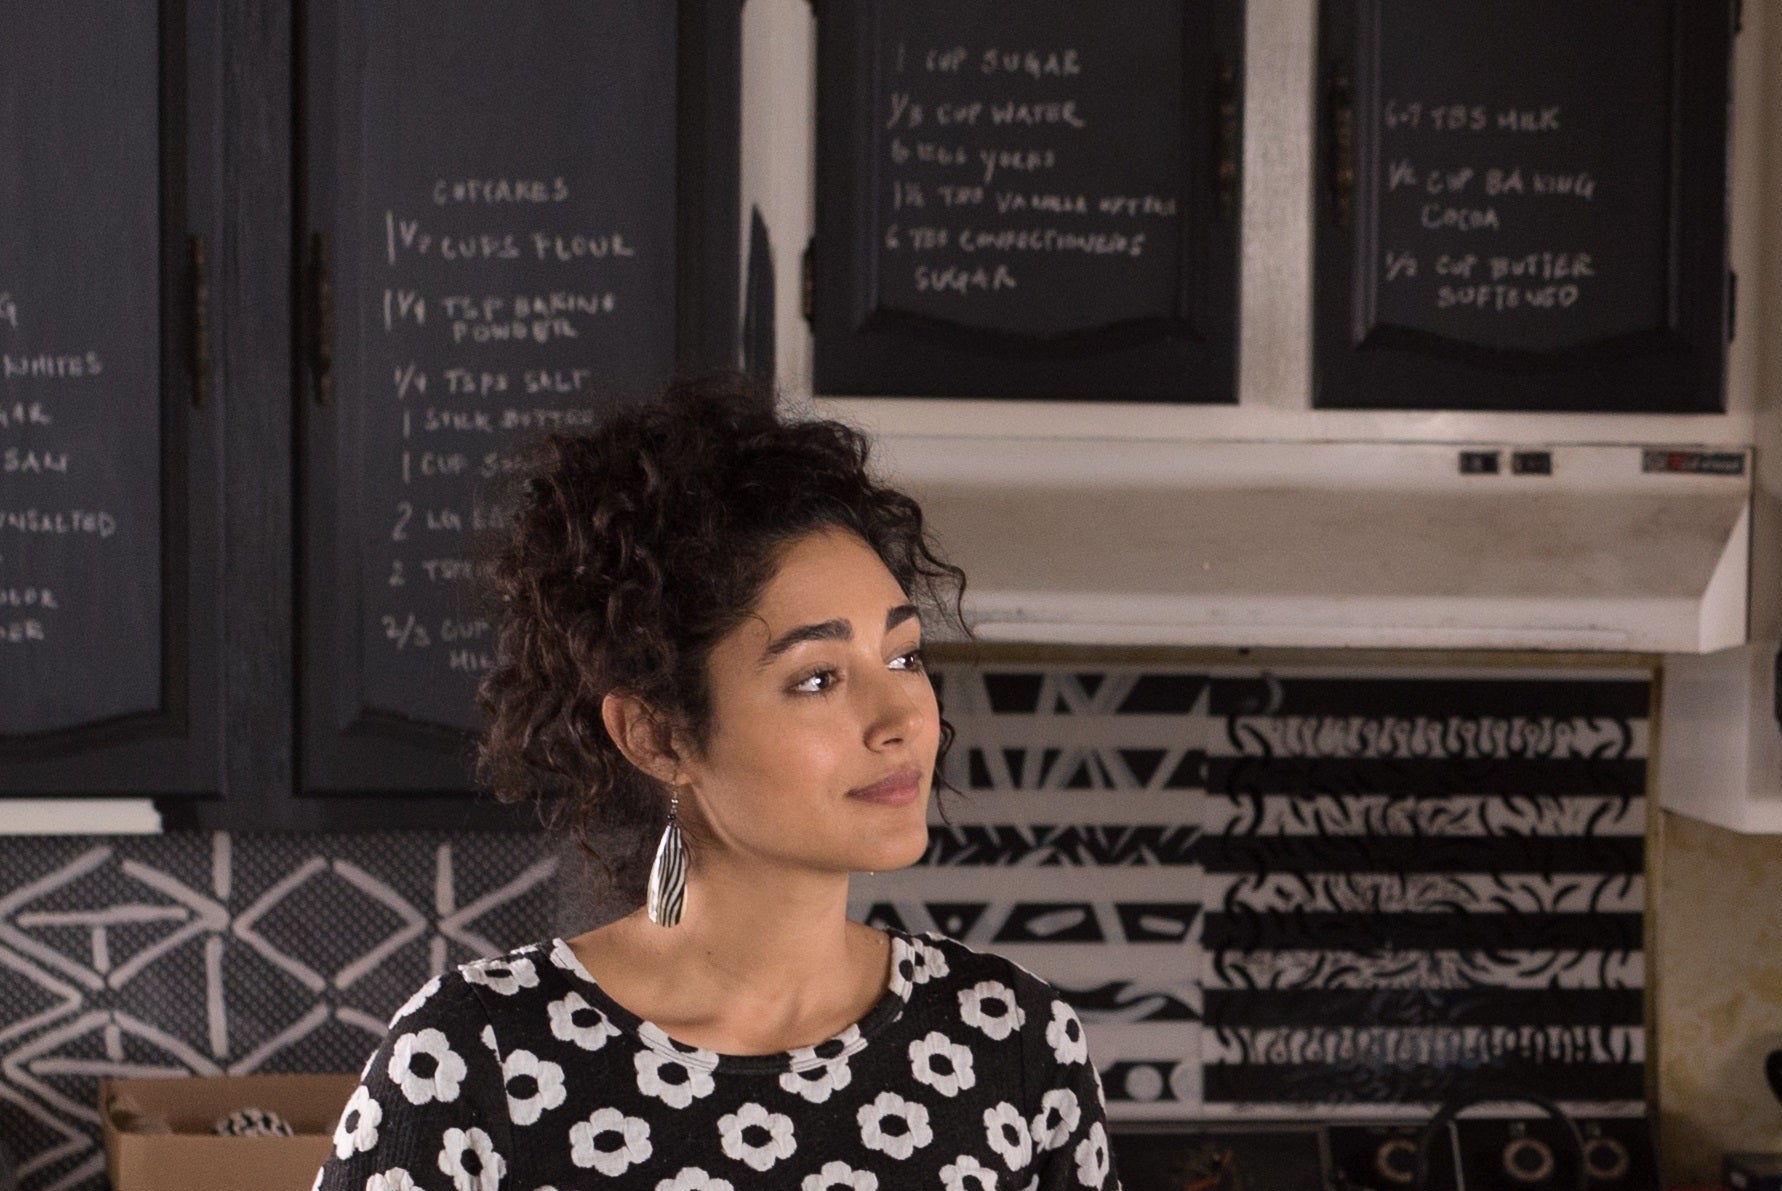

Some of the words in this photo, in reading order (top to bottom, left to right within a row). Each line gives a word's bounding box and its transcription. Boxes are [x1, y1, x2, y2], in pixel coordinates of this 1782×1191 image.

[981, 48, 1081, 79] SUGAR
[936, 102, 983, 126] CUP
[991, 100, 1085, 128] WATER
[432, 177, 569, 206] CUPCAKES
[1484, 168, 1595, 199] BAKING
[1420, 203, 1500, 231] COCOA
[440, 234, 520, 260] CUPS
[532, 232, 634, 262] FLOUR
[915, 264, 1017, 294] SUGAR
[1489, 252, 1594, 281] BUTTER
[441, 296, 504, 324] TSP
[514, 293, 615, 318] BAKING
[1436, 284, 1579, 311] SOFTENED
[452, 317, 577, 344] POWDER
[2, 351, 102, 378] WHITES
[524, 369, 588, 394] SALT
[420, 451, 467, 476] CUP
[391, 501, 414, 542] 2
[439, 617, 490, 642] CUP
